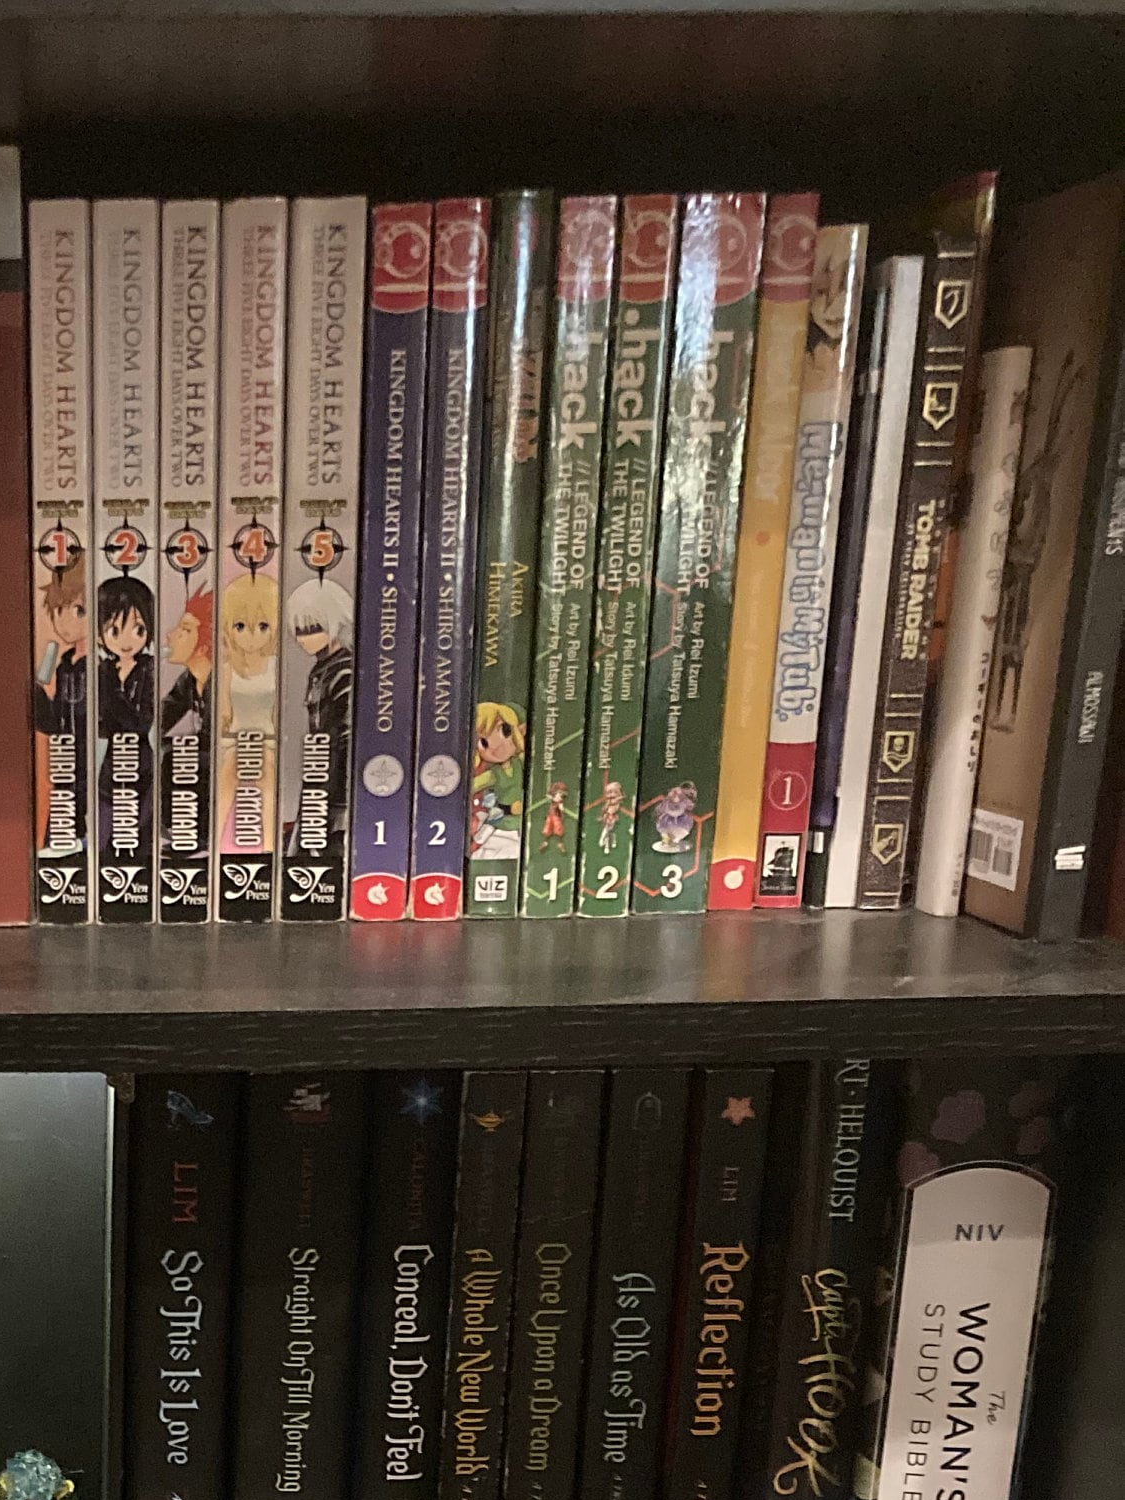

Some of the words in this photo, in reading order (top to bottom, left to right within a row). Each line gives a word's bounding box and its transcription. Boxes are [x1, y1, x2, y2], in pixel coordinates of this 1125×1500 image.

[123, 228, 144, 372] KINGDOM
[186, 226, 208, 372] KINGDOM
[615, 307, 662, 448] .hack
[185, 382, 207, 487] HEARTS
[386, 349, 407, 469] KINGDOM
[123, 384, 144, 489] HEARTS
[171, 453, 186, 487] TWO
[555, 463, 573, 499] THE
[613, 459, 629, 497] THE
[383, 468, 403, 549] HEARTS
[572, 480, 589, 559] LEGEND
[628, 478, 646, 557] LEGEND
[912, 499, 937, 569] TOMB
[114, 533, 139, 565] 2
[175, 533, 200, 566] 3
[382, 553, 399, 567] II
[552, 505, 570, 596] TWILIGHT
[608, 502, 626, 594] TWILIGHT
[570, 564, 585, 590] OF
[626, 563, 641, 588] OF
[379, 585, 399, 650] SHIRO
[485, 561, 507, 669] HIMEKAWA
[605, 602, 619, 633] Story
[623, 620, 635, 635] by
[626, 602, 636, 618] Art
[781, 606, 825, 649] My
[901, 574, 927, 661] RAIDER
[605, 634, 617, 648] by
[623, 638, 636, 661] Rei
[377, 654, 395, 733] AMANO
[600, 652, 617, 703] Tatsuya
[778, 643, 820, 712] Tub
[113, 733, 139, 783] SHIRO
[172, 735, 199, 785] SHIRO
[599, 706, 614, 769] Hamazaki
[781, 776, 794, 806] 1
[112, 788, 139, 849] AMANO
[171, 790, 198, 850] AMANO
[373, 821, 387, 845] 1
[429, 821, 447, 845] 2
[124, 893, 148, 903] Press
[130, 883, 148, 893] Yen
[543, 868, 559, 900] 1
[595, 866, 619, 899] 2
[660, 865, 684, 898] 3
[829, 1103, 865, 1223] HELQUIST
[174, 1162, 198, 1224] LIM
[465, 1248, 494, 1263] A
[954, 1224, 1004, 1241] NIV
[160, 1250, 204, 1292] So
[284, 1247, 320, 1334] Straight
[535, 1243, 572, 1305] Once
[613, 1272, 656, 1309] As
[160, 1295, 203, 1361] This
[461, 1270, 503, 1346] Whole
[282, 1341, 314, 1368] On
[528, 1309, 568, 1373] Upon
[611, 1316, 651, 1364] Old
[690, 1240, 751, 1437] Reflection
[911, 1303, 946, 1403] STUDY
[160, 1368, 201, 1393] Is
[280, 1368, 315, 1409] Till
[386, 1355, 428, 1421] Don't
[456, 1351, 494, 1404] New
[534, 1379, 554, 1391] a
[609, 1370, 634, 1401] as
[159, 1400, 200, 1465] Love
[525, 1396, 562, 1472] Dream
[604, 1398, 647, 1463] Time
[987, 1391, 1006, 1425] The
[275, 1411, 311, 1493] Morning
[385, 1425, 424, 1481] Feel
[453, 1407, 492, 1476] World
